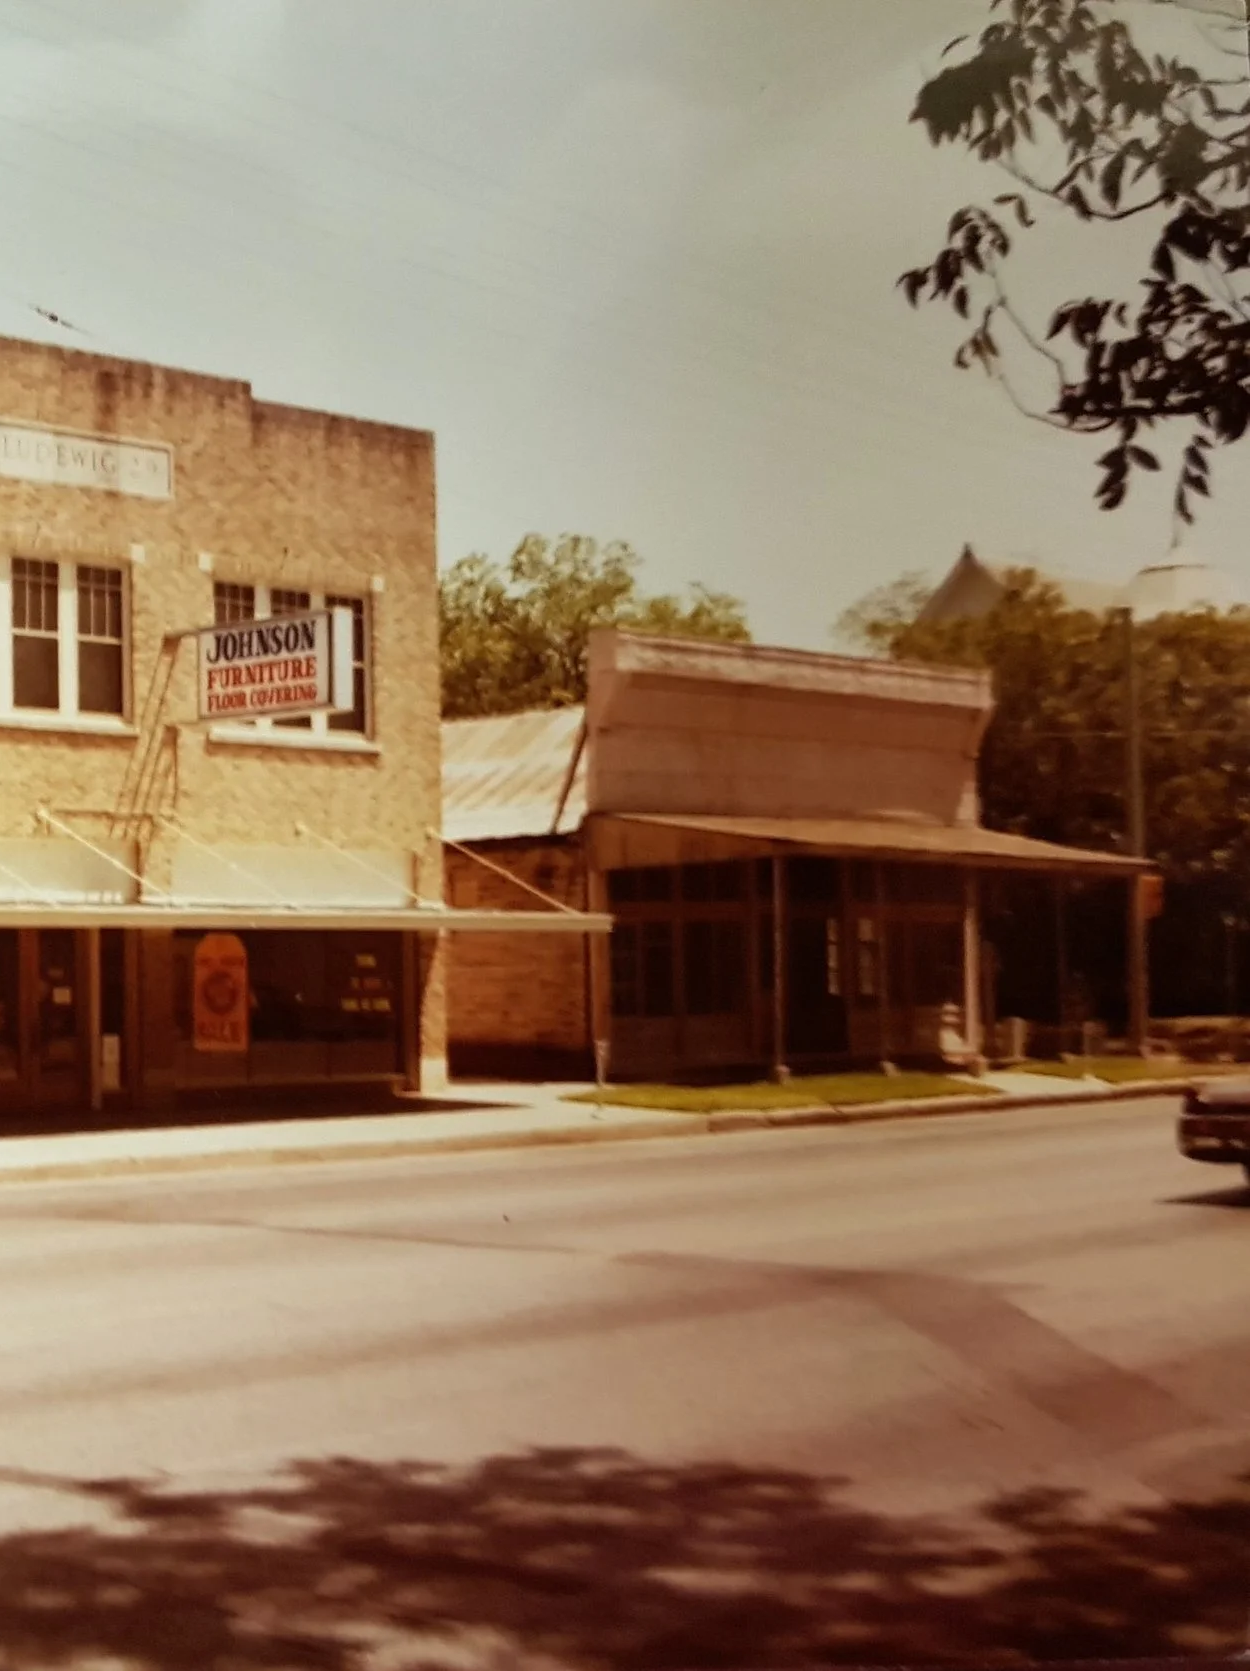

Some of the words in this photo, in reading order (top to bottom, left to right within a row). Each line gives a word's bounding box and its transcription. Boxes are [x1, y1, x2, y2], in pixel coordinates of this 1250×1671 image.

[2, 433, 118, 475] LUDEWIG
[206, 619, 317, 664] JOHNSON
[207, 656, 317, 691] FURNITURE
[207, 690, 247, 713] FLOOR
